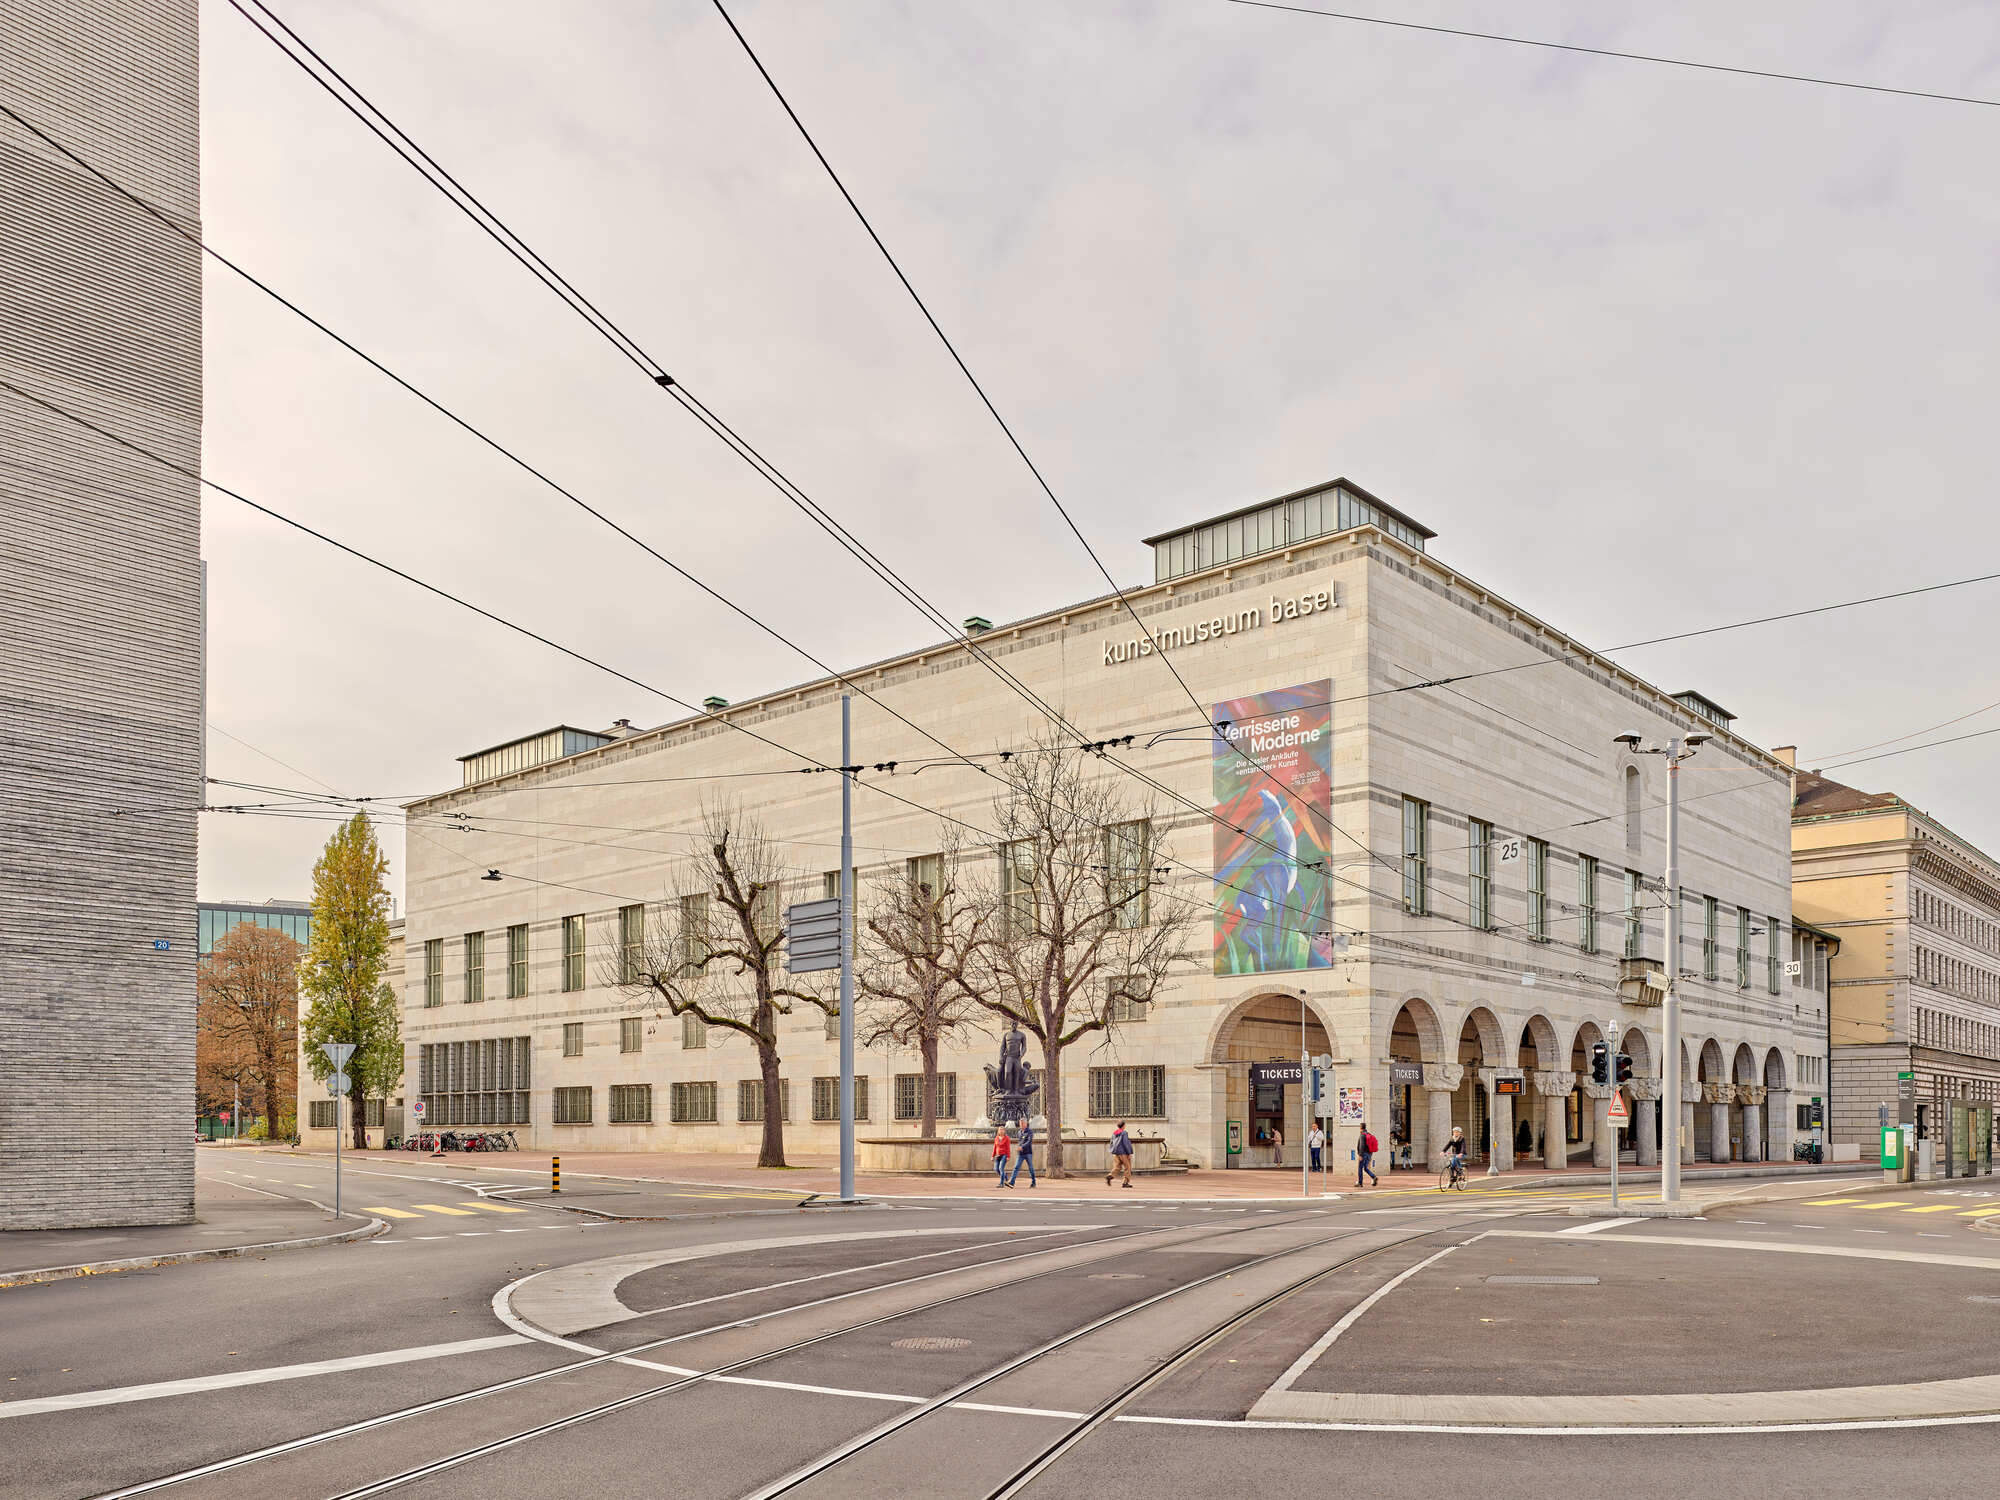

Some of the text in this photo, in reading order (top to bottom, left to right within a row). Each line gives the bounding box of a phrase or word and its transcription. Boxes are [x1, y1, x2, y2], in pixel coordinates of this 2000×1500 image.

[1102, 576, 1338, 665] kunstmuseum basel
[1251, 728, 1320, 753] Moderne
[1236, 760, 1247, 768] Die
[1270, 751, 1299, 761] Ankäufe
[1278, 759, 1298, 769] Kunst
[1502, 842, 1518, 861] 25
[157, 941, 168, 949] 20
[1786, 964, 1799, 973] 30
[1260, 1068, 1302, 1079] TICKETS
[1395, 1069, 1419, 1080] TICKETS
